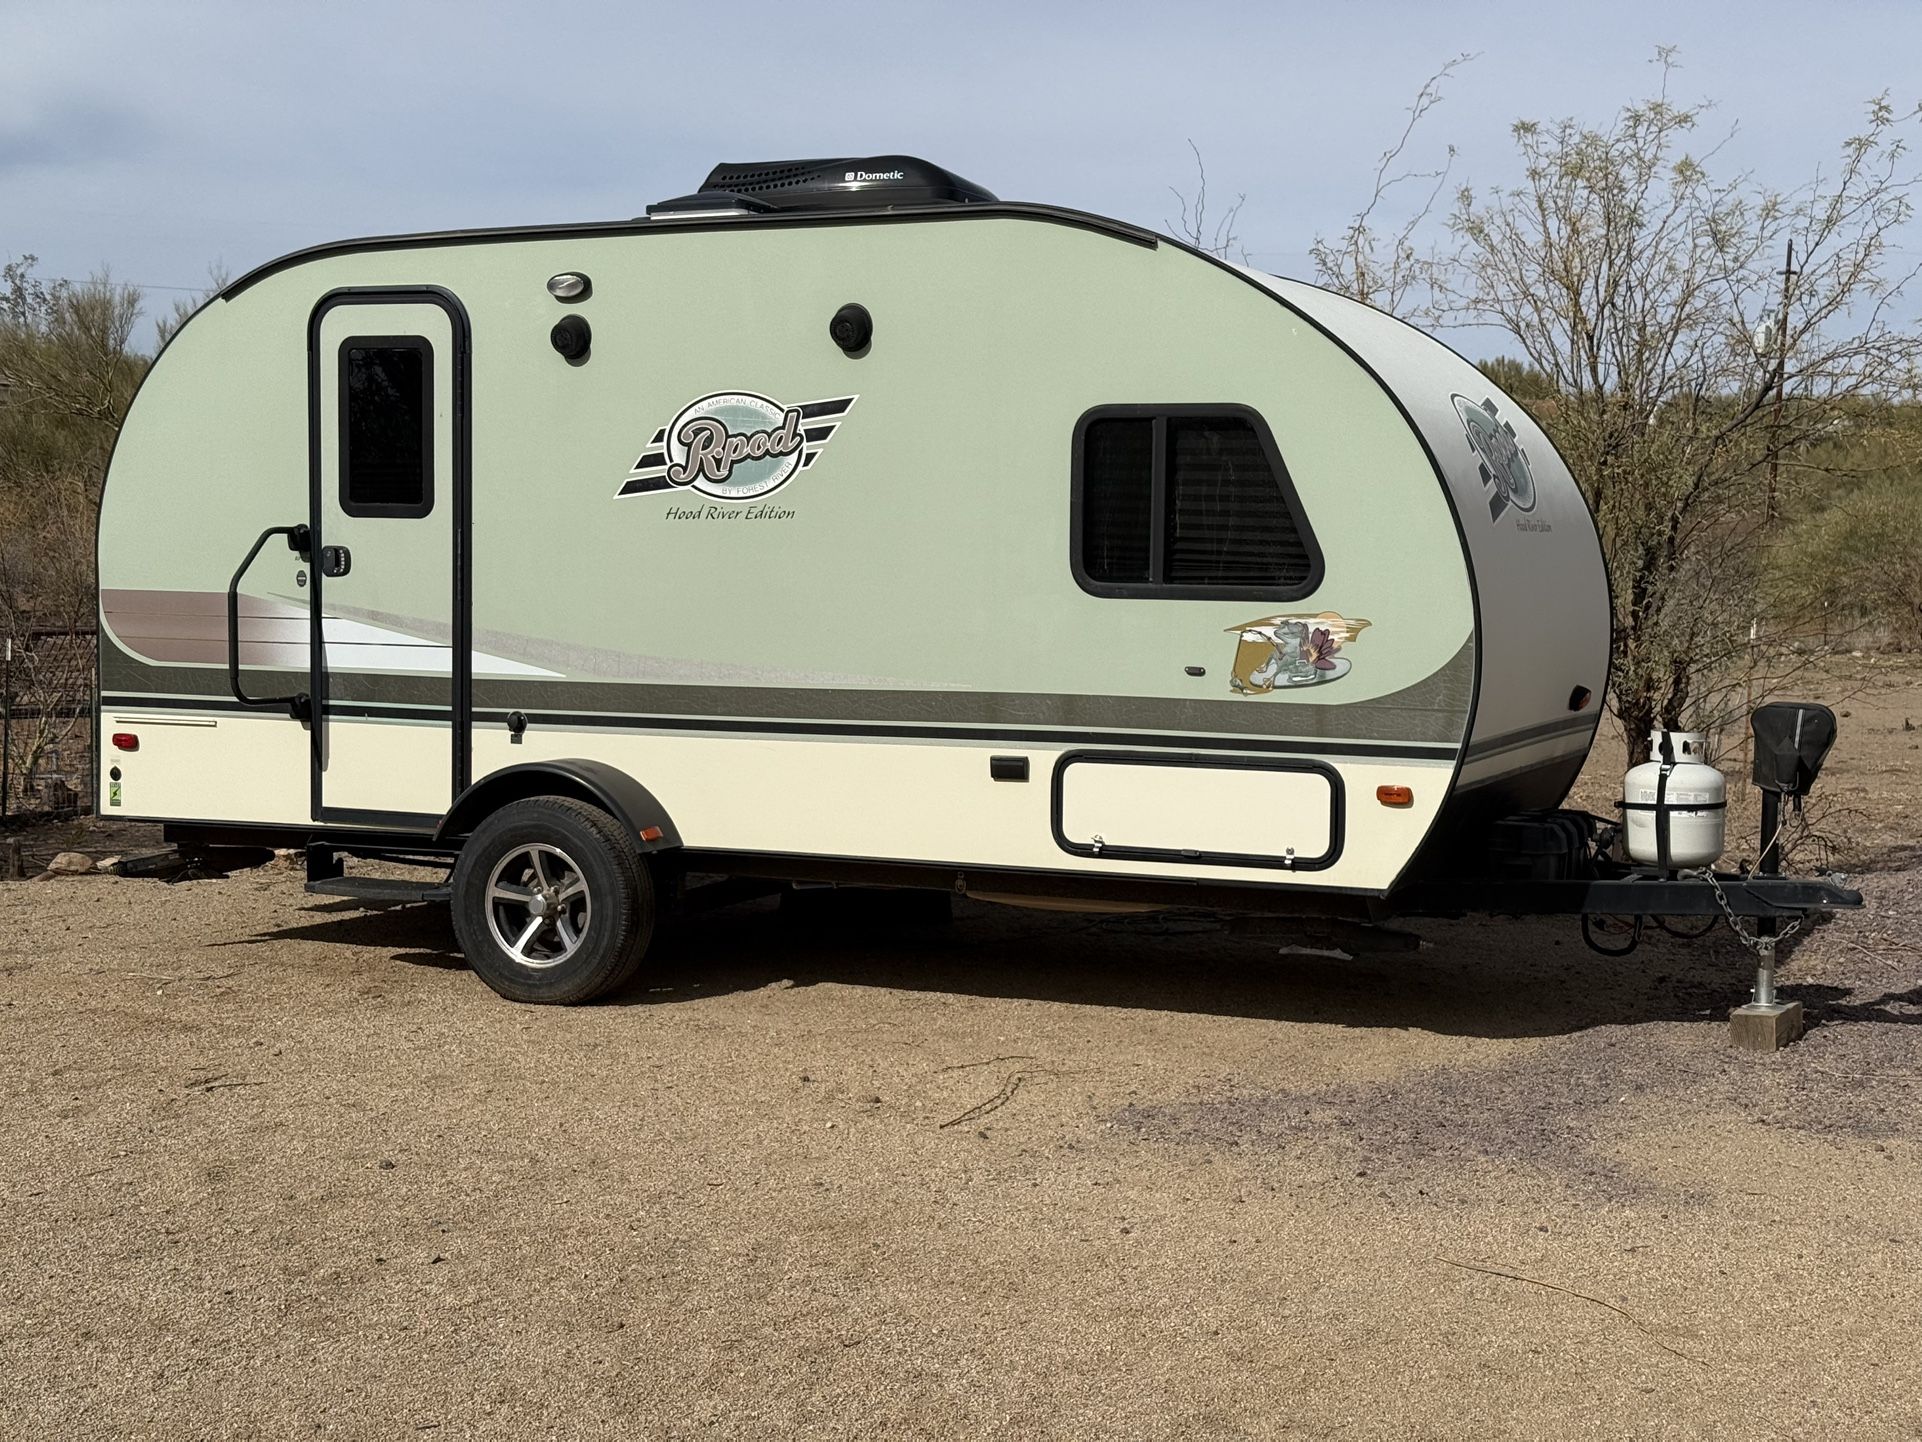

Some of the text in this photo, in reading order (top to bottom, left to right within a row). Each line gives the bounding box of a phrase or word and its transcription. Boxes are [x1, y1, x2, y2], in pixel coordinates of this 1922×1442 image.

[856, 170, 904, 181] Dometic
[694, 398, 781, 420] AN AMERICAN CLASSIC
[721, 486, 733, 495] BY
[665, 503, 796, 520] Hood River Edition
